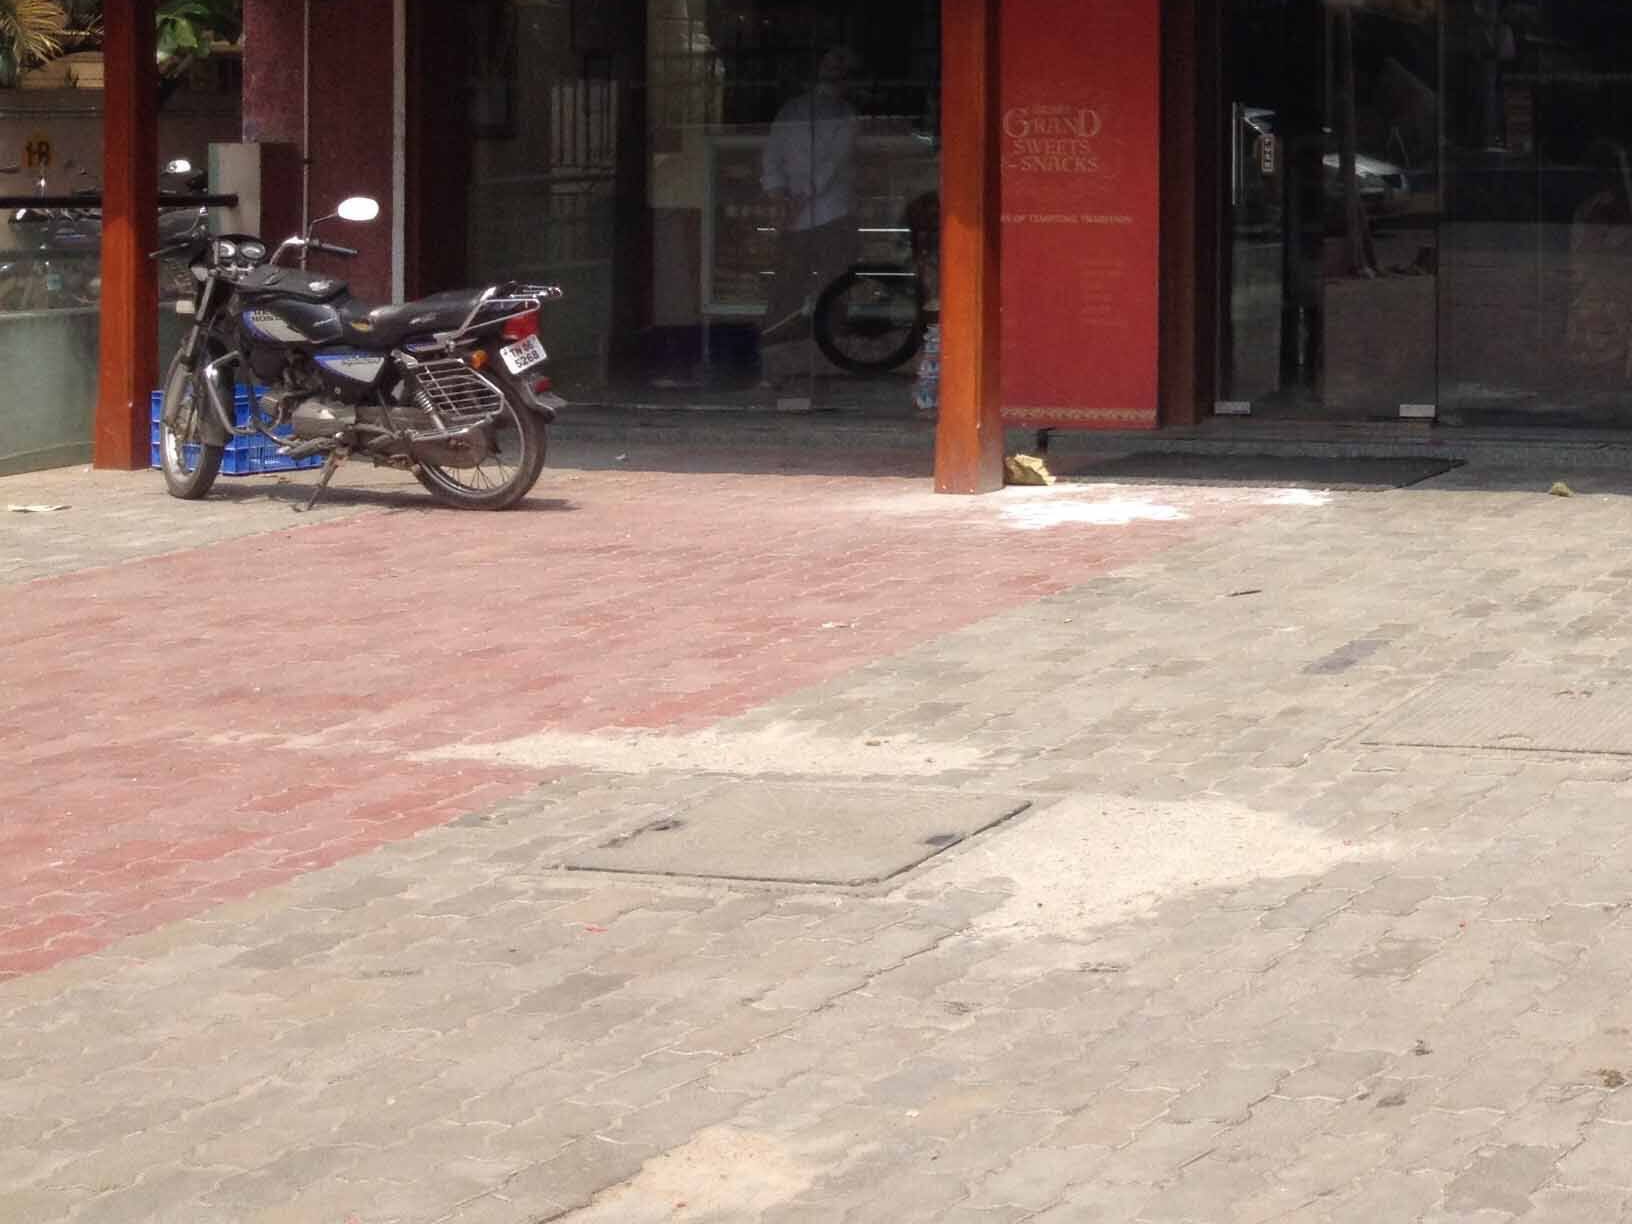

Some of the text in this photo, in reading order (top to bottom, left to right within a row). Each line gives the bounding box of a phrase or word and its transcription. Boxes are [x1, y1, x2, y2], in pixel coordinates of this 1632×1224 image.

[1002, 107, 1102, 138] GRAND
[1012, 138, 1092, 155] SWEETS
[1021, 155, 1098, 173] SNACKS
